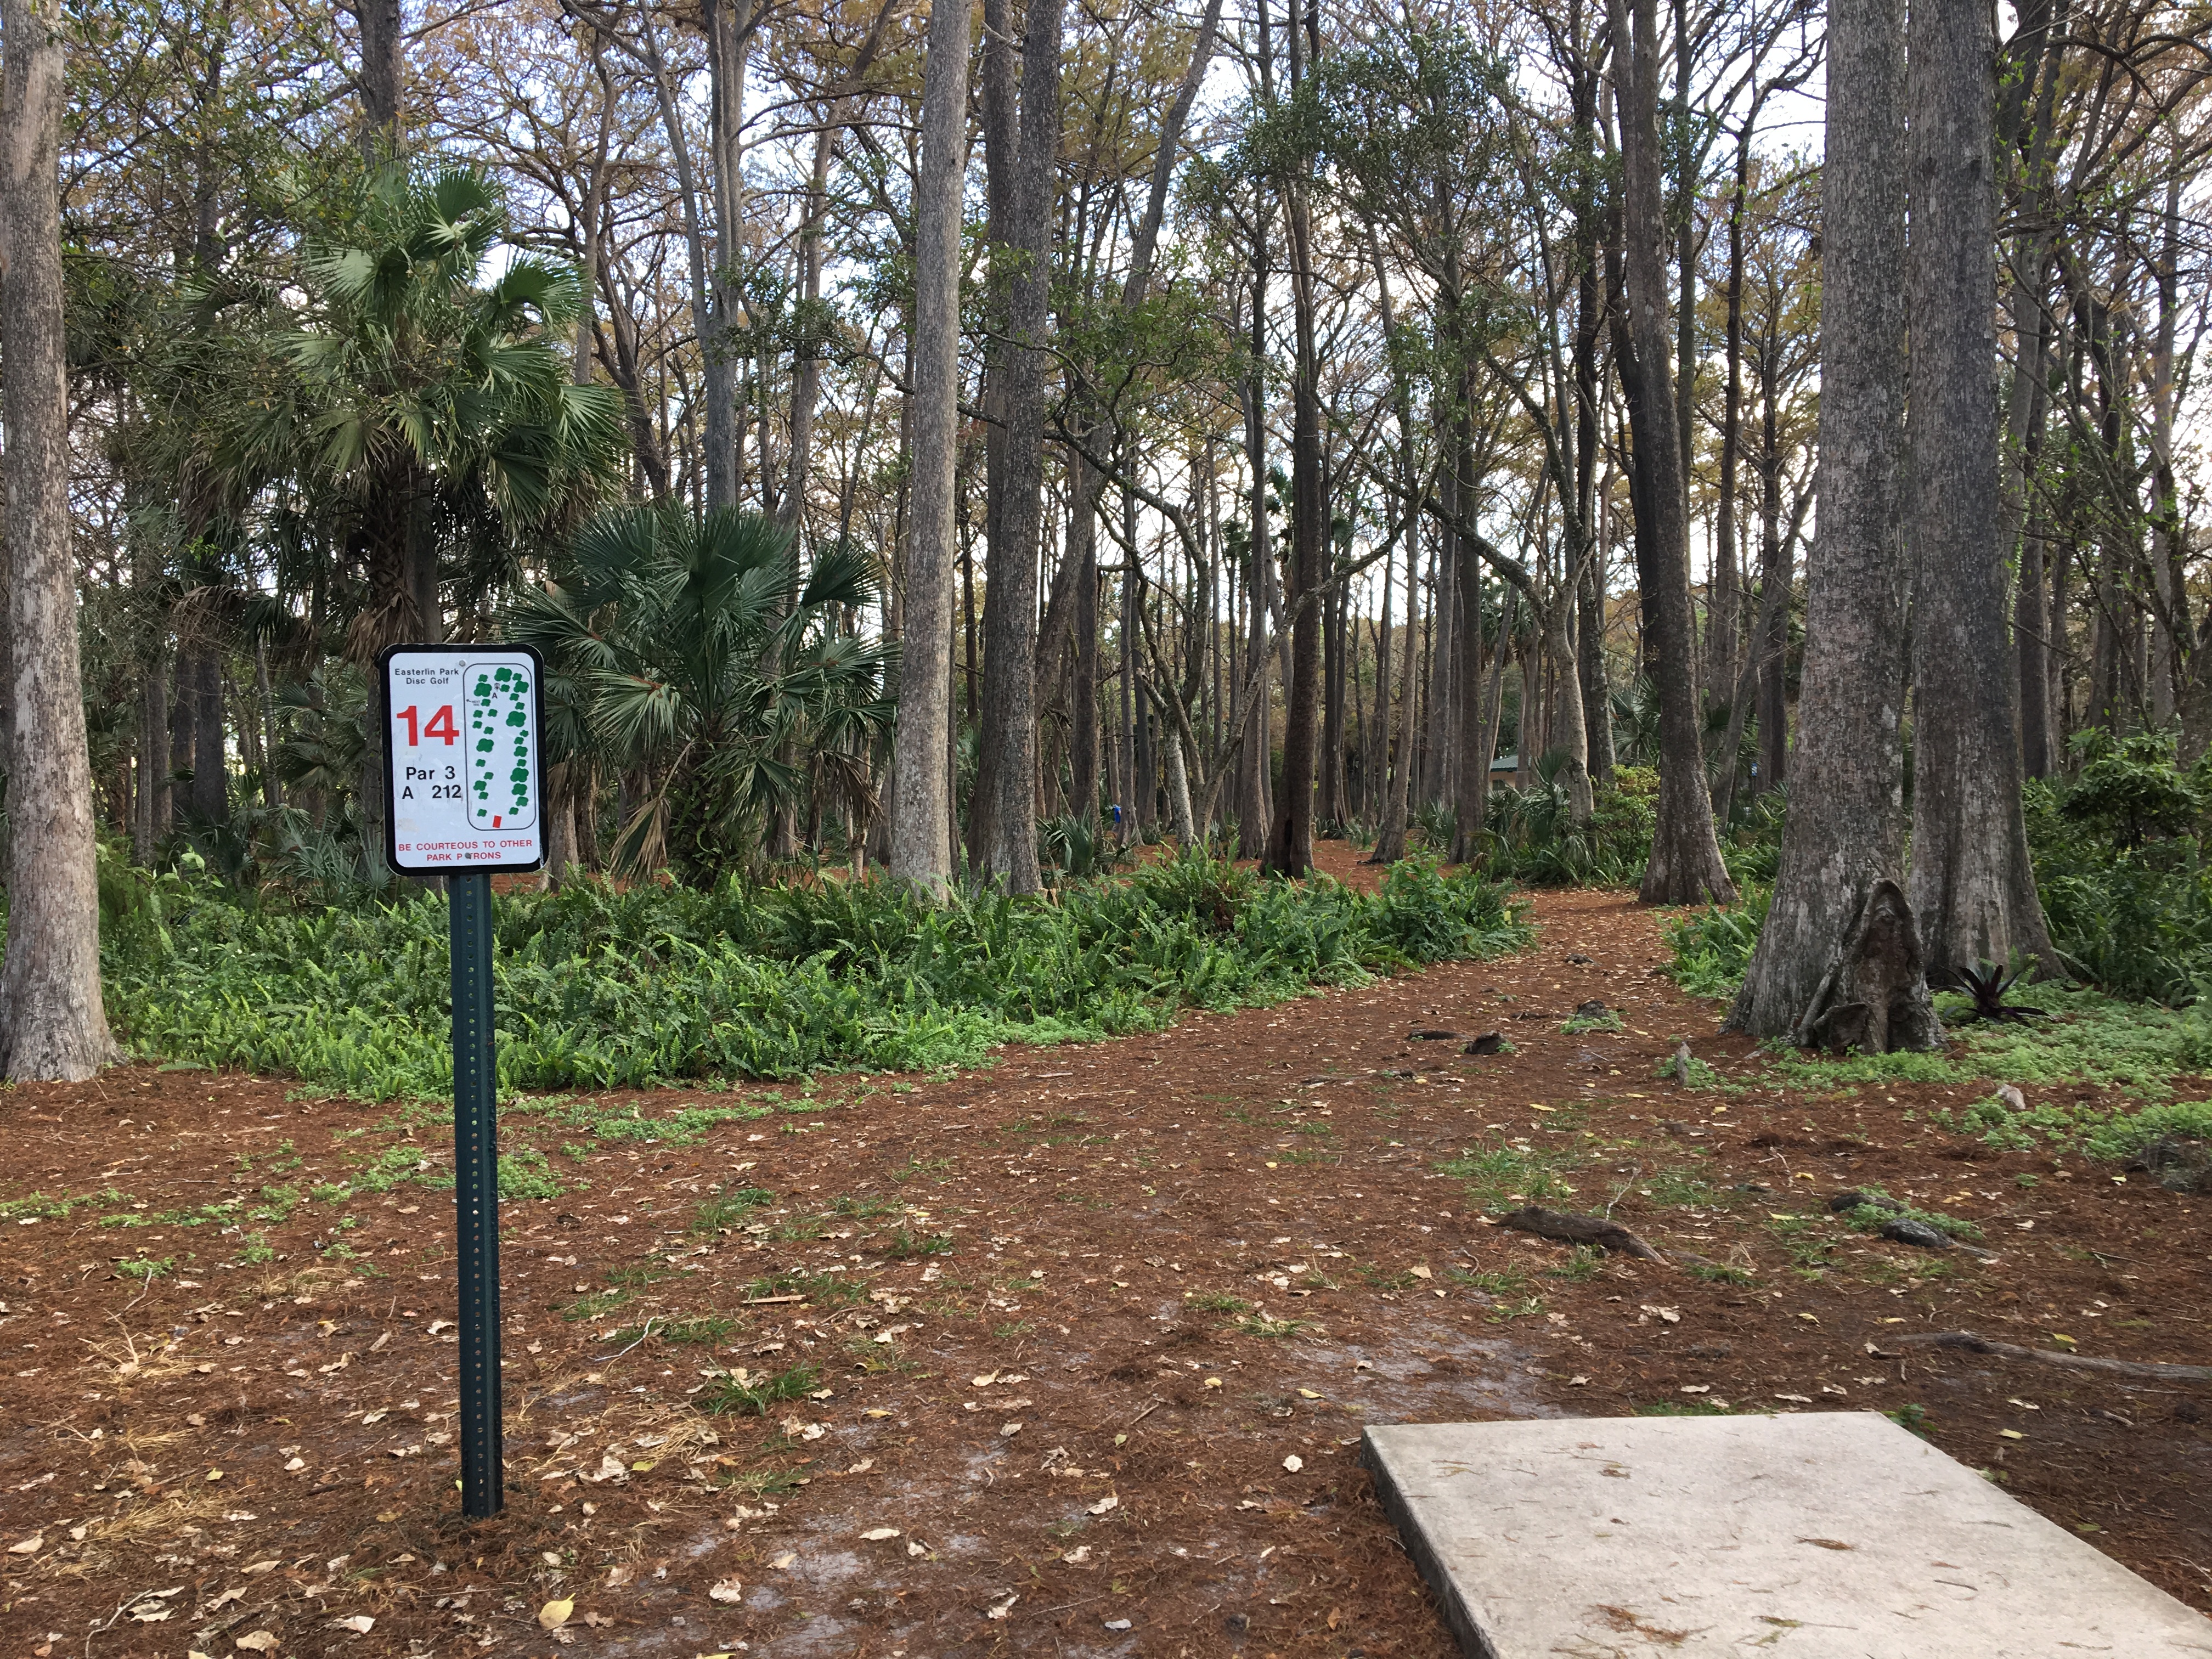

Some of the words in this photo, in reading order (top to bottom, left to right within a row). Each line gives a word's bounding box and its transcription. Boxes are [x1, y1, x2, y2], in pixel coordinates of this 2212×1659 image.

[396, 705, 459, 746] 14
[406, 767, 435, 780] Par
[445, 766, 455, 780] 3
[402, 786, 414, 799] A
[432, 785, 461, 799] 212
[416, 842, 478, 850] COURTEOUS
[500, 839, 533, 848] OTHER
